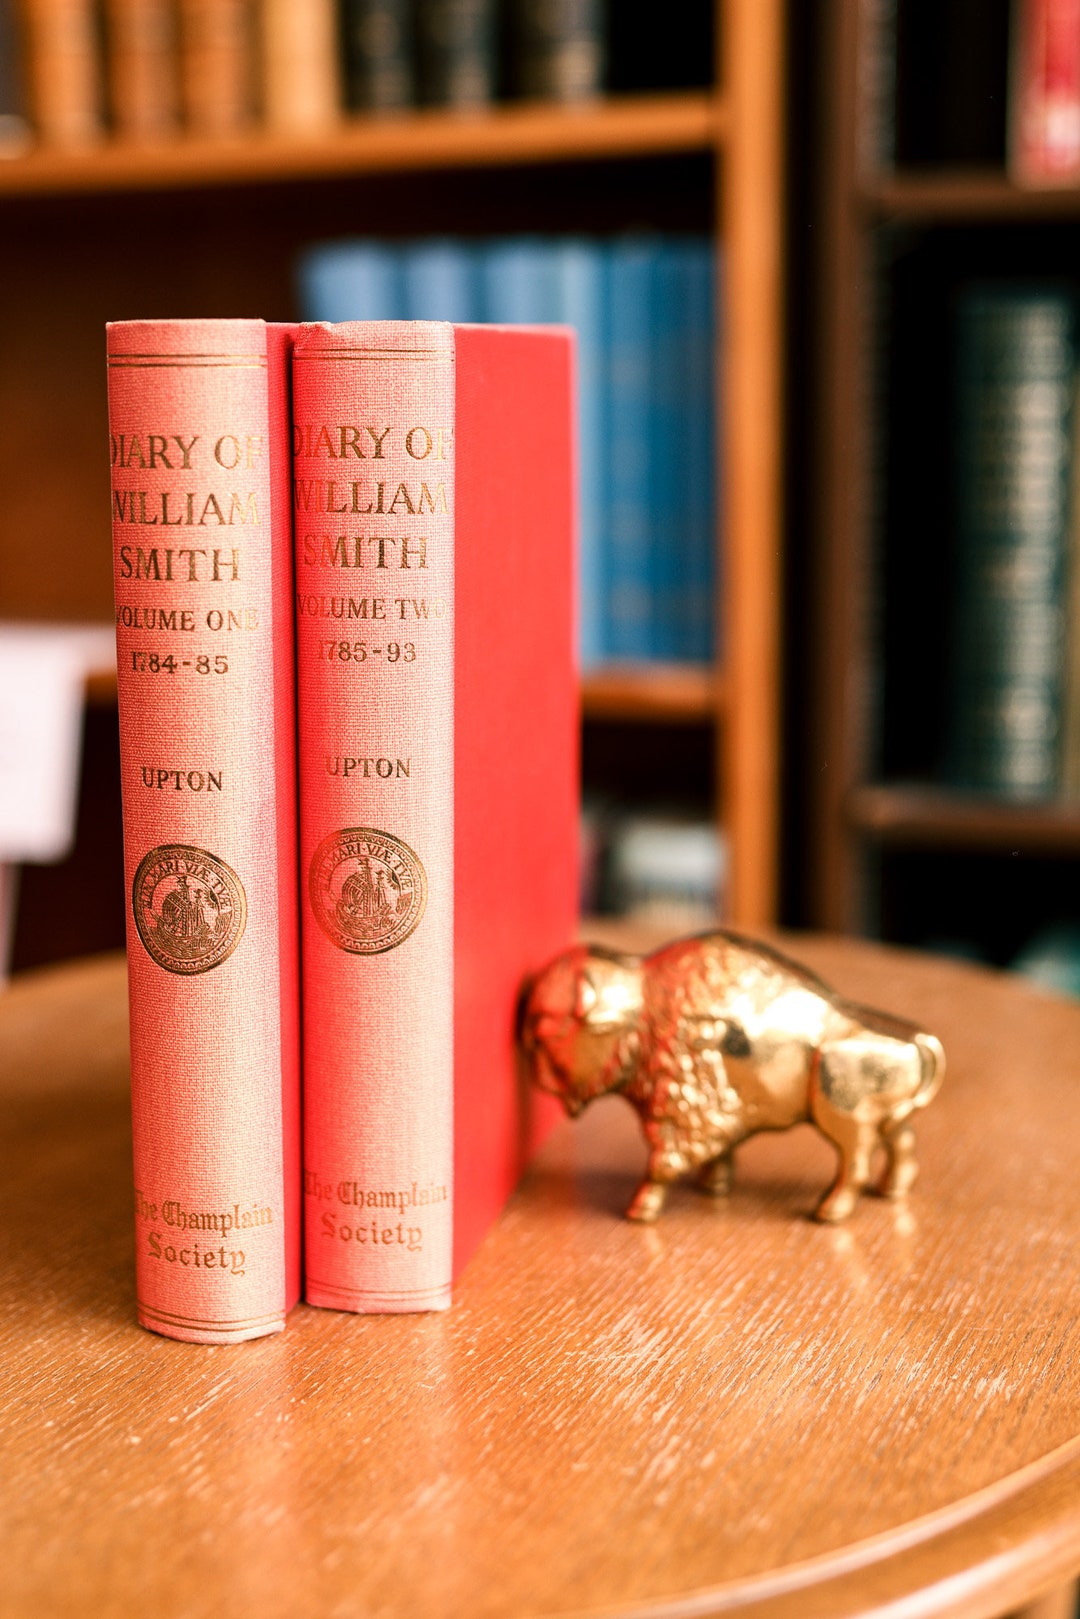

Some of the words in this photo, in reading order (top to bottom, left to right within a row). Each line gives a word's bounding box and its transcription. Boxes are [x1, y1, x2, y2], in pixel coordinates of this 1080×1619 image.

[214, 434, 264, 470] OF
[295, 425, 394, 460] DIARY
[405, 426, 453, 461] OF
[295, 480, 451, 515] WILLIAM
[119, 545, 240, 581] SMITH
[303, 535, 429, 569] SMITH
[206, 609, 260, 632] ONE
[296, 596, 387, 621] VOLUME
[394, 598, 449, 621] TWO
[130, 651, 229, 675] 1784-85
[318, 640, 417, 664] 1785-93
[141, 766, 223, 792] UPTON
[325, 756, 412, 779] UPTON
[304, 1170, 332, 1202] The
[336, 1180, 448, 1214] Champlain
[162, 1200, 273, 1238] Champlain
[321, 1212, 423, 1251] Society
[147, 1231, 246, 1276] Society
